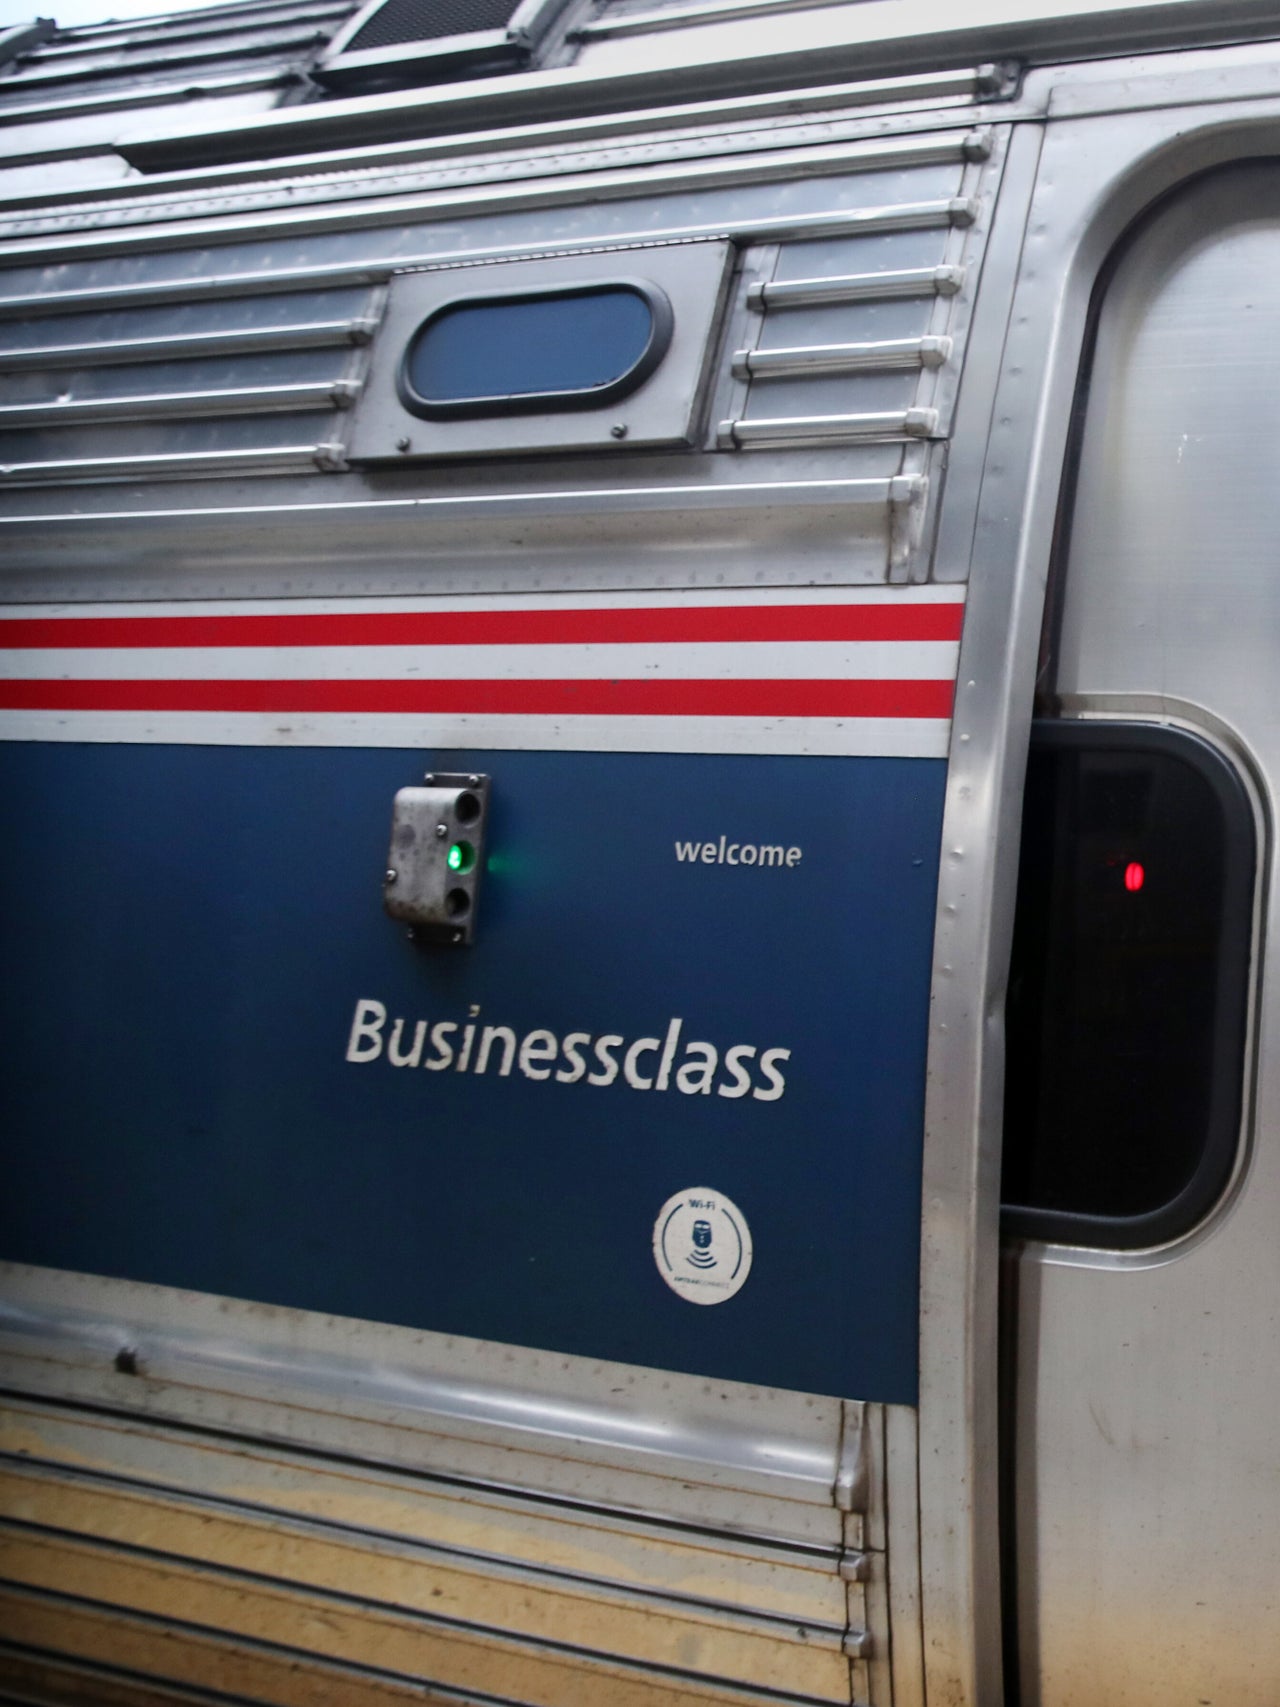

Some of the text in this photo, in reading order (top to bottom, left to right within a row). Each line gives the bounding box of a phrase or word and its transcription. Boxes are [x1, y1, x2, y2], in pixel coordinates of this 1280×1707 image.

[675, 835, 803, 868] welcome
[345, 998, 791, 1101] Businessclass
[688, 1198, 716, 1211] Wi-Fi
